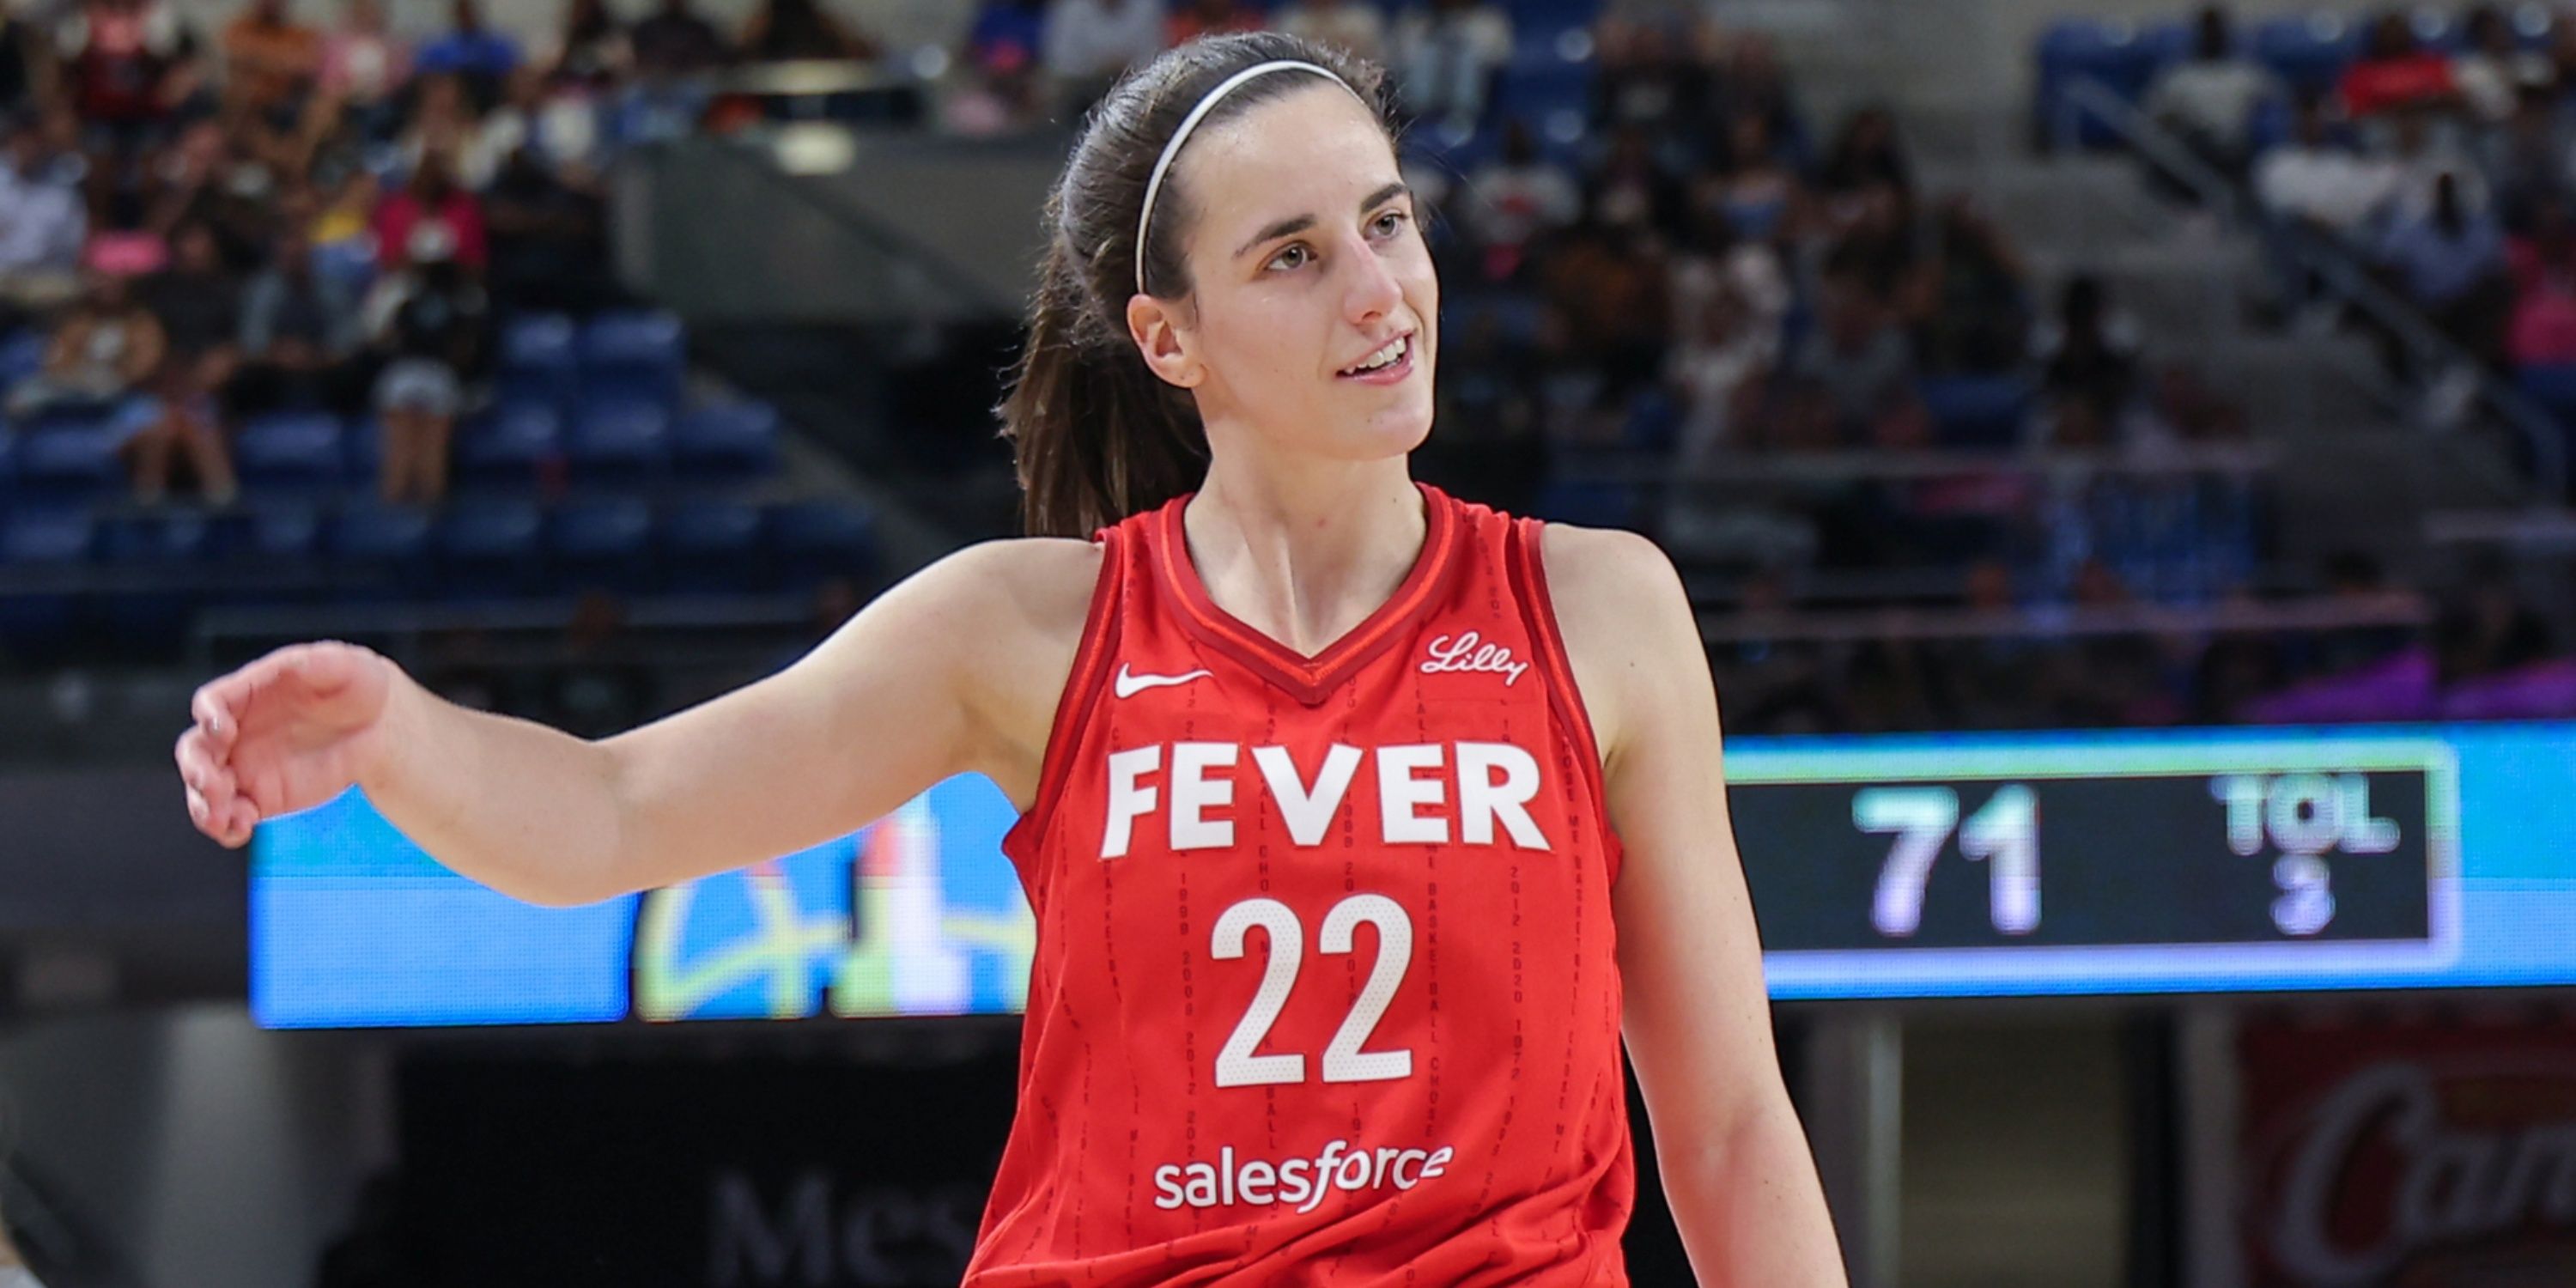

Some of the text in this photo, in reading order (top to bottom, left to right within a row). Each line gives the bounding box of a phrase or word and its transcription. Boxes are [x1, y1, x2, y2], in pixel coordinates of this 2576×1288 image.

[1420, 631, 1528, 686] Lilly
[1099, 741, 1552, 860] FEVER
[2209, 771, 2402, 856] TOL
[1851, 783, 2043, 936] 71
[1211, 894, 1414, 1088] 22
[1154, 1139, 1454, 1214] salesforce
